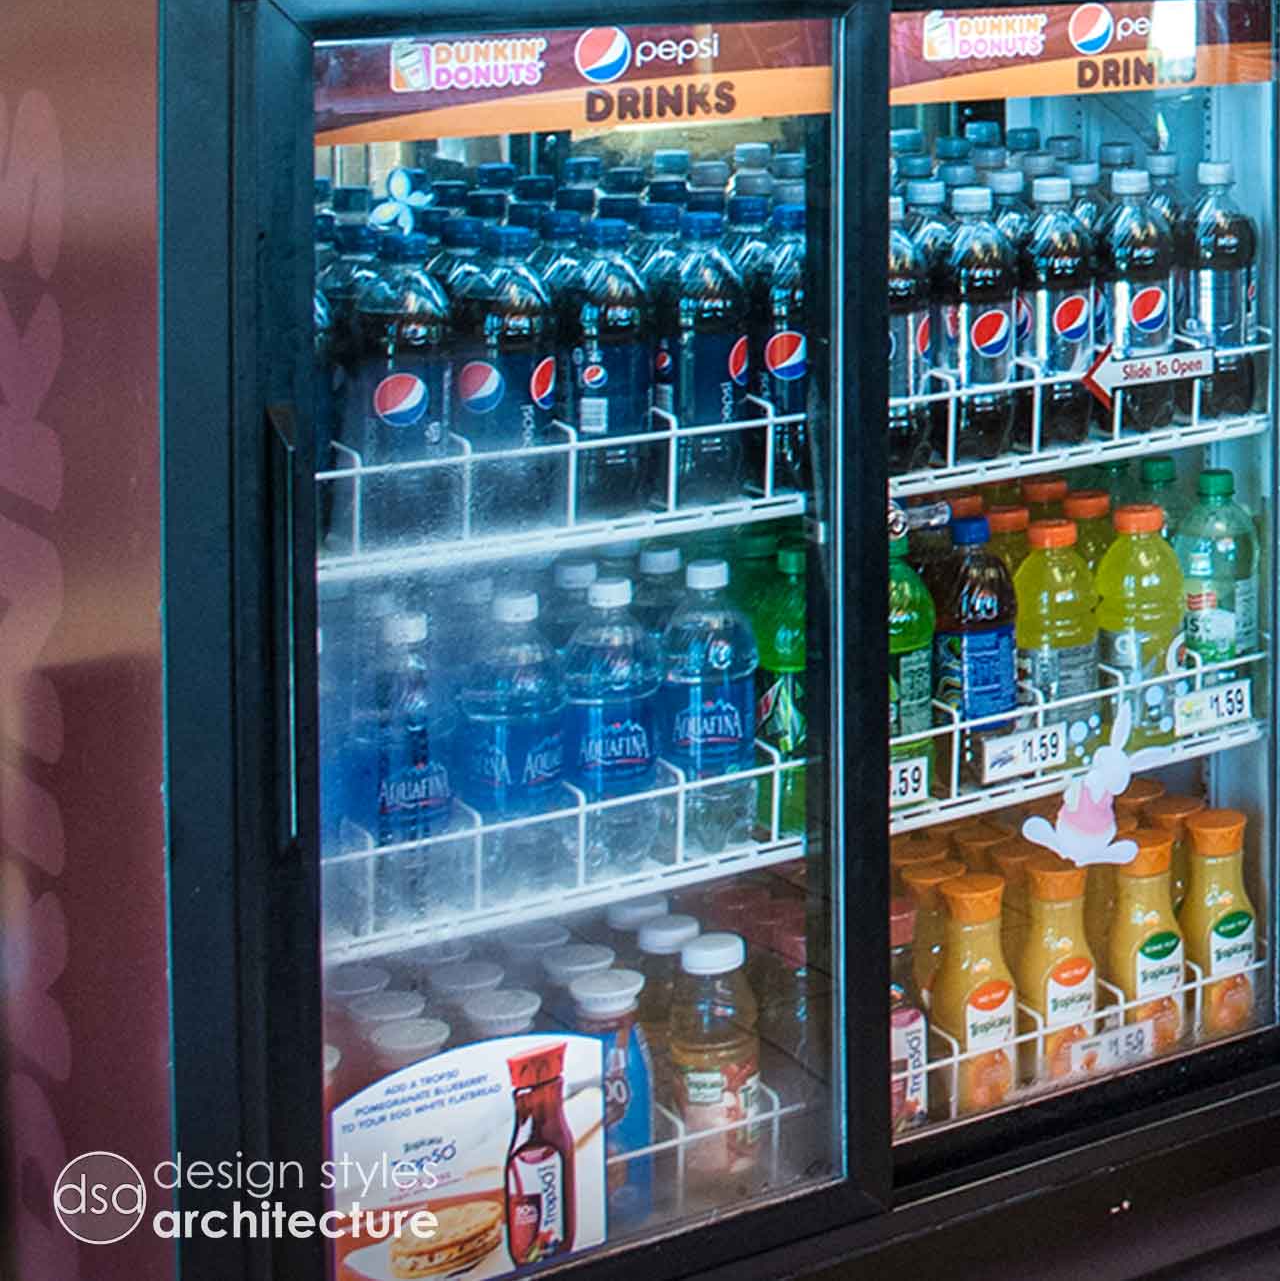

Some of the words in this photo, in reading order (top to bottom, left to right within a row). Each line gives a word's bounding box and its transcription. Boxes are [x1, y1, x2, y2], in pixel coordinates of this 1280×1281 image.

[957, 14, 1047, 37] DUNKIN'
[434, 38, 547, 65] DUNKIN'
[634, 33, 719, 69] pepsi
[957, 36, 1045, 59] DONUTS
[434, 63, 544, 89] DONUTS
[585, 81, 737, 123] DRINKS
[1122, 362, 1152, 380] Slide
[1155, 361, 1169, 377] To
[1171, 358, 1203, 379] Open
[673, 704, 745, 745] AQUAFINA
[579, 726, 651, 767] AQUAFINA
[355, 1090, 431, 1117] POMEGRANATE
[433, 1074, 489, 1098] BLUEBERRY
[385, 1082, 406, 1097] ADD
[359, 1114, 387, 1131] YOUR
[390, 1107, 412, 1122] EGG
[415, 1098, 445, 1116] WHITE
